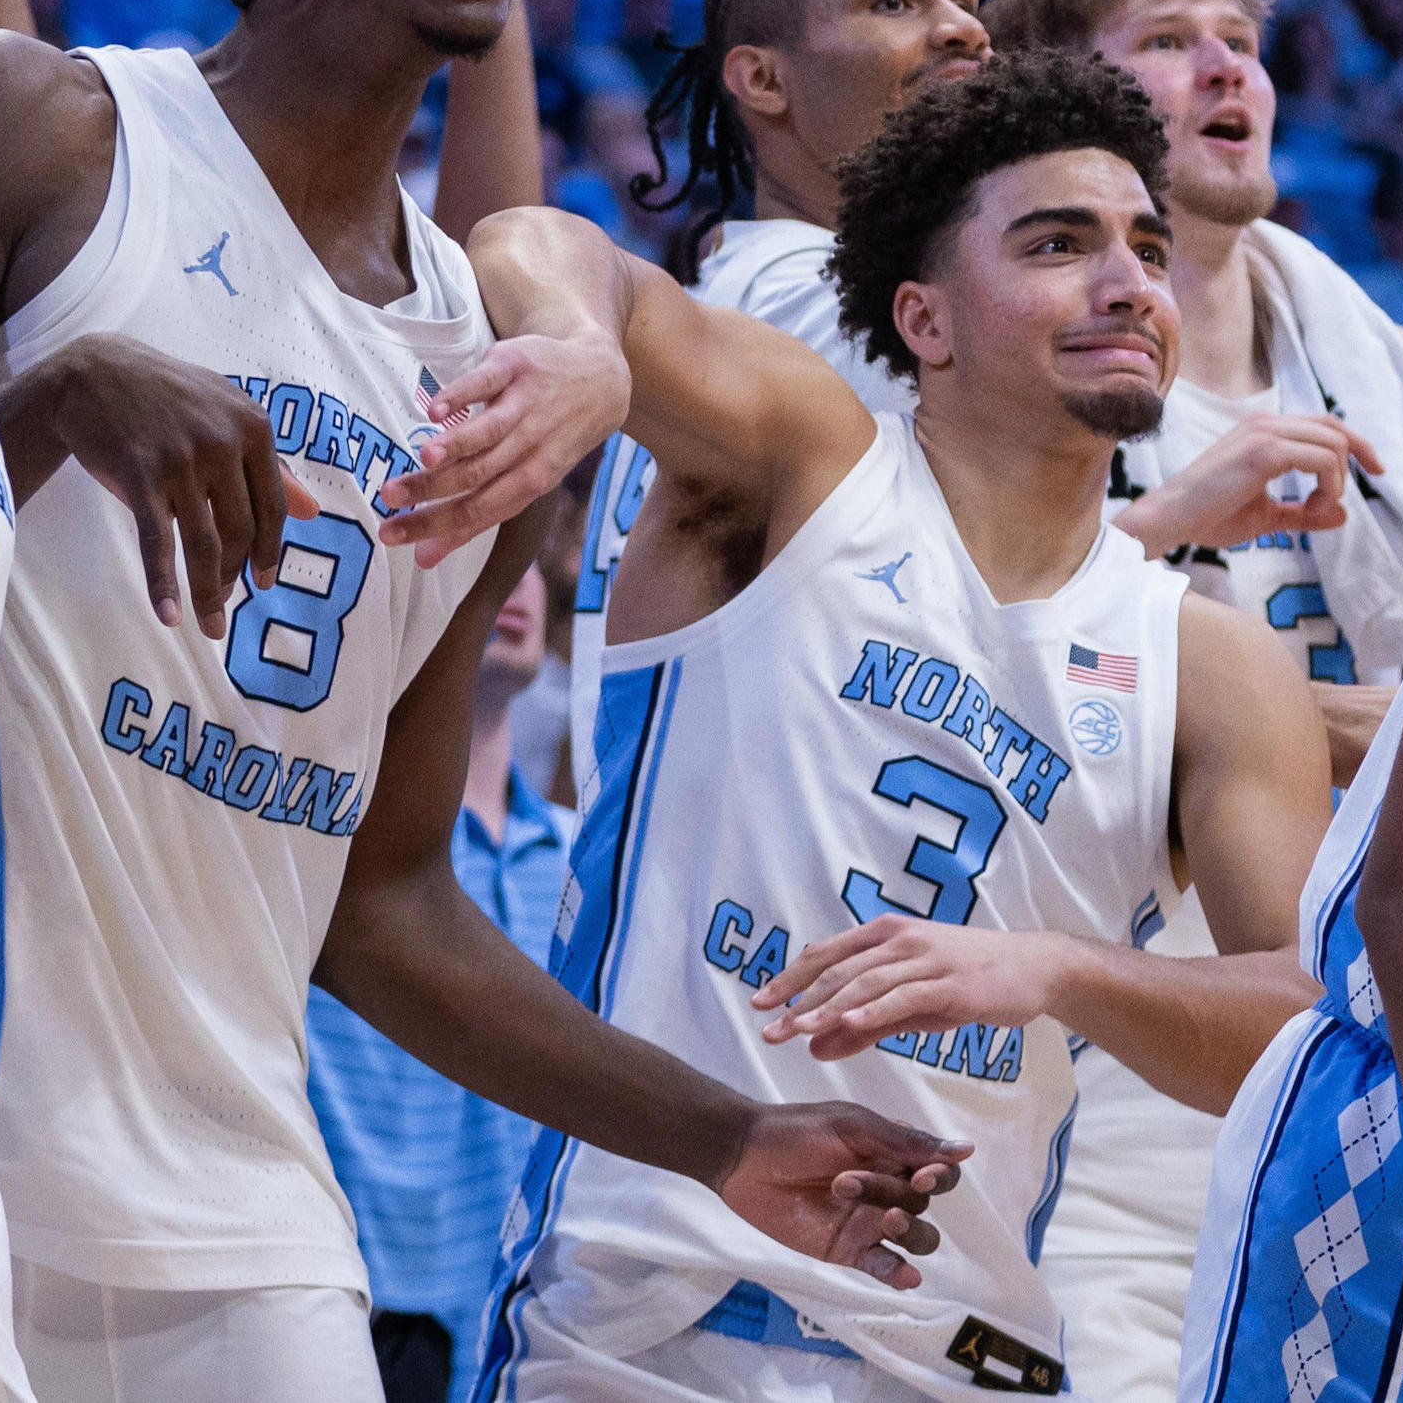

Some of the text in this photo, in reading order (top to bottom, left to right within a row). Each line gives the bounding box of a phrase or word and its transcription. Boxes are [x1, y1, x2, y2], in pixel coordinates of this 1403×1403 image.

[224, 508, 376, 714] 8
[839, 639, 1072, 825] NORTH
[841, 754, 1008, 926] 3
